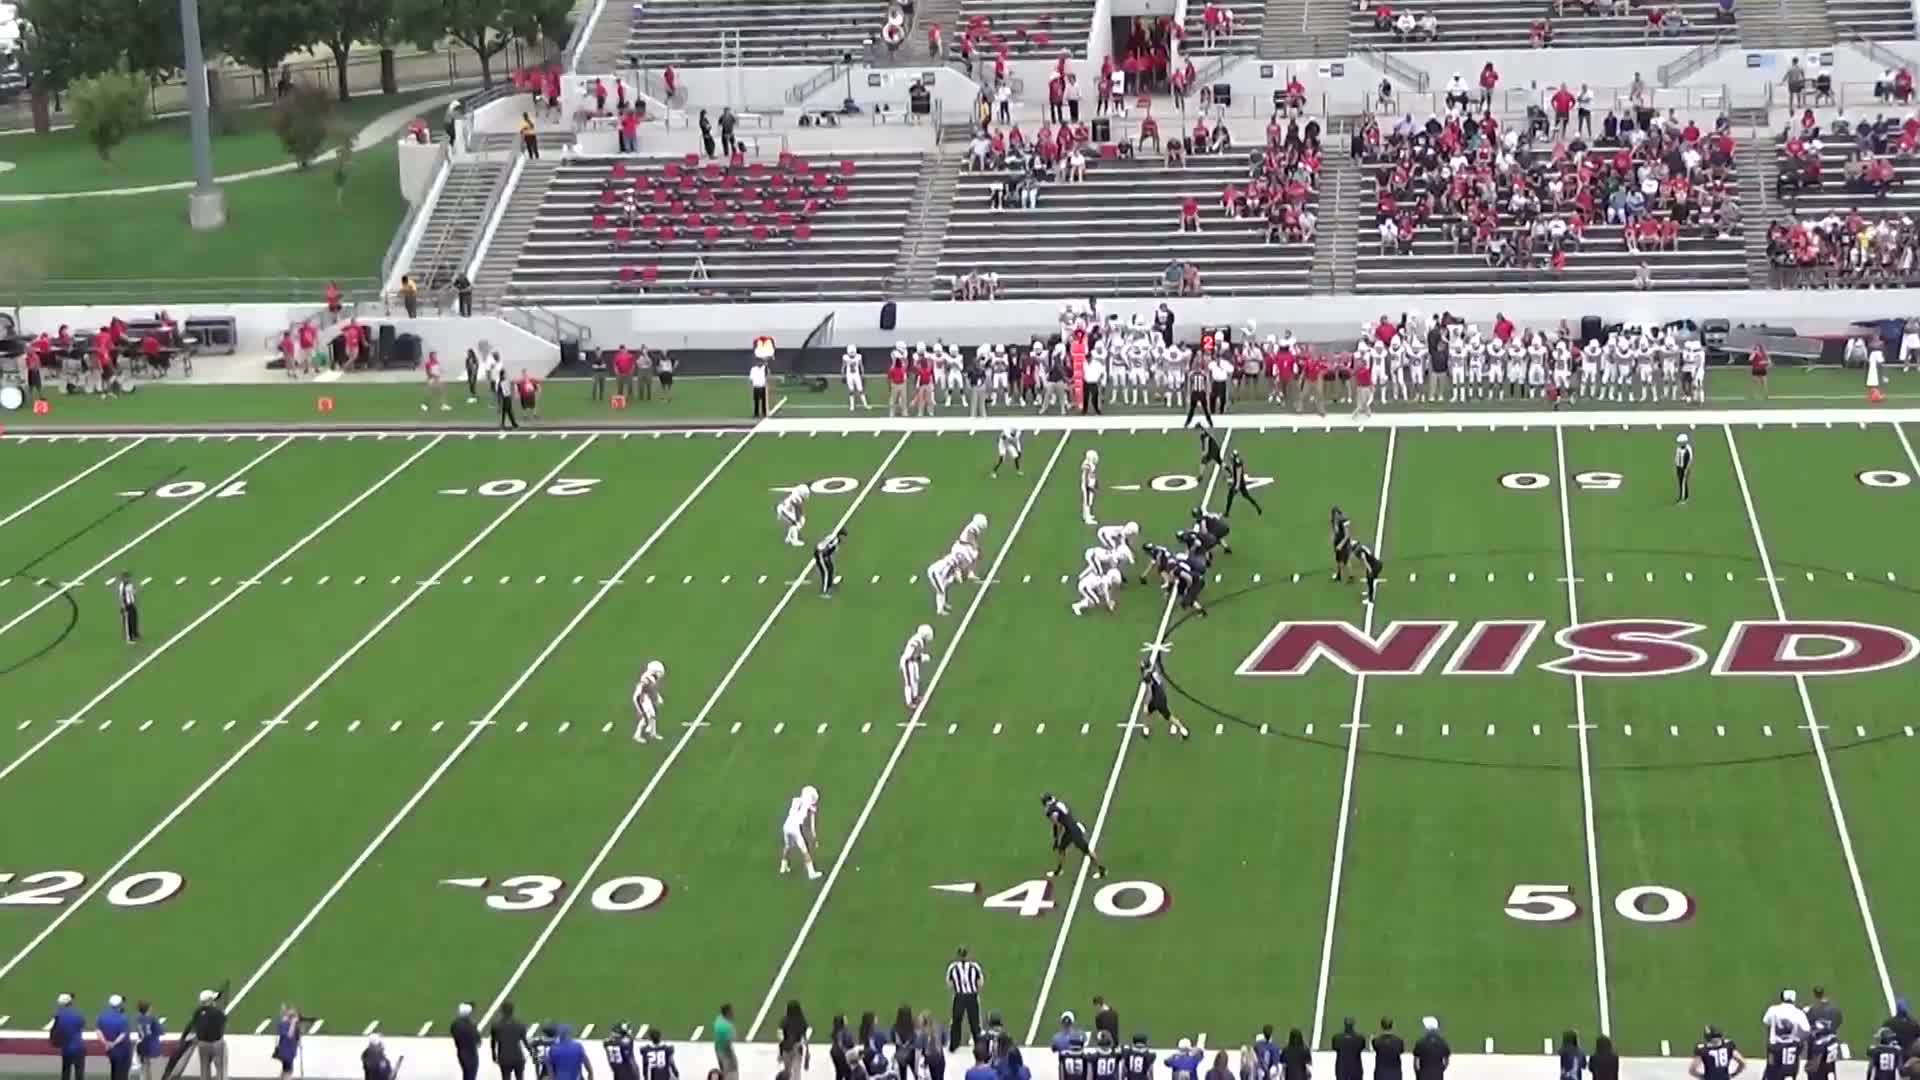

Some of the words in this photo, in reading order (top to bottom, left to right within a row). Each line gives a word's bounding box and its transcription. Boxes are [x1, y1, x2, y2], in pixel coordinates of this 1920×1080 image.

[478, 479, 601, 496] 20
[810, 476, 931, 494] 30
[1500, 471, 1623, 489] 50
[1234, 620, 1920, 676] NISD
[486, 876, 668, 911] 30
[983, 880, 1171, 917] 40
[1504, 885, 1696, 922] 50
